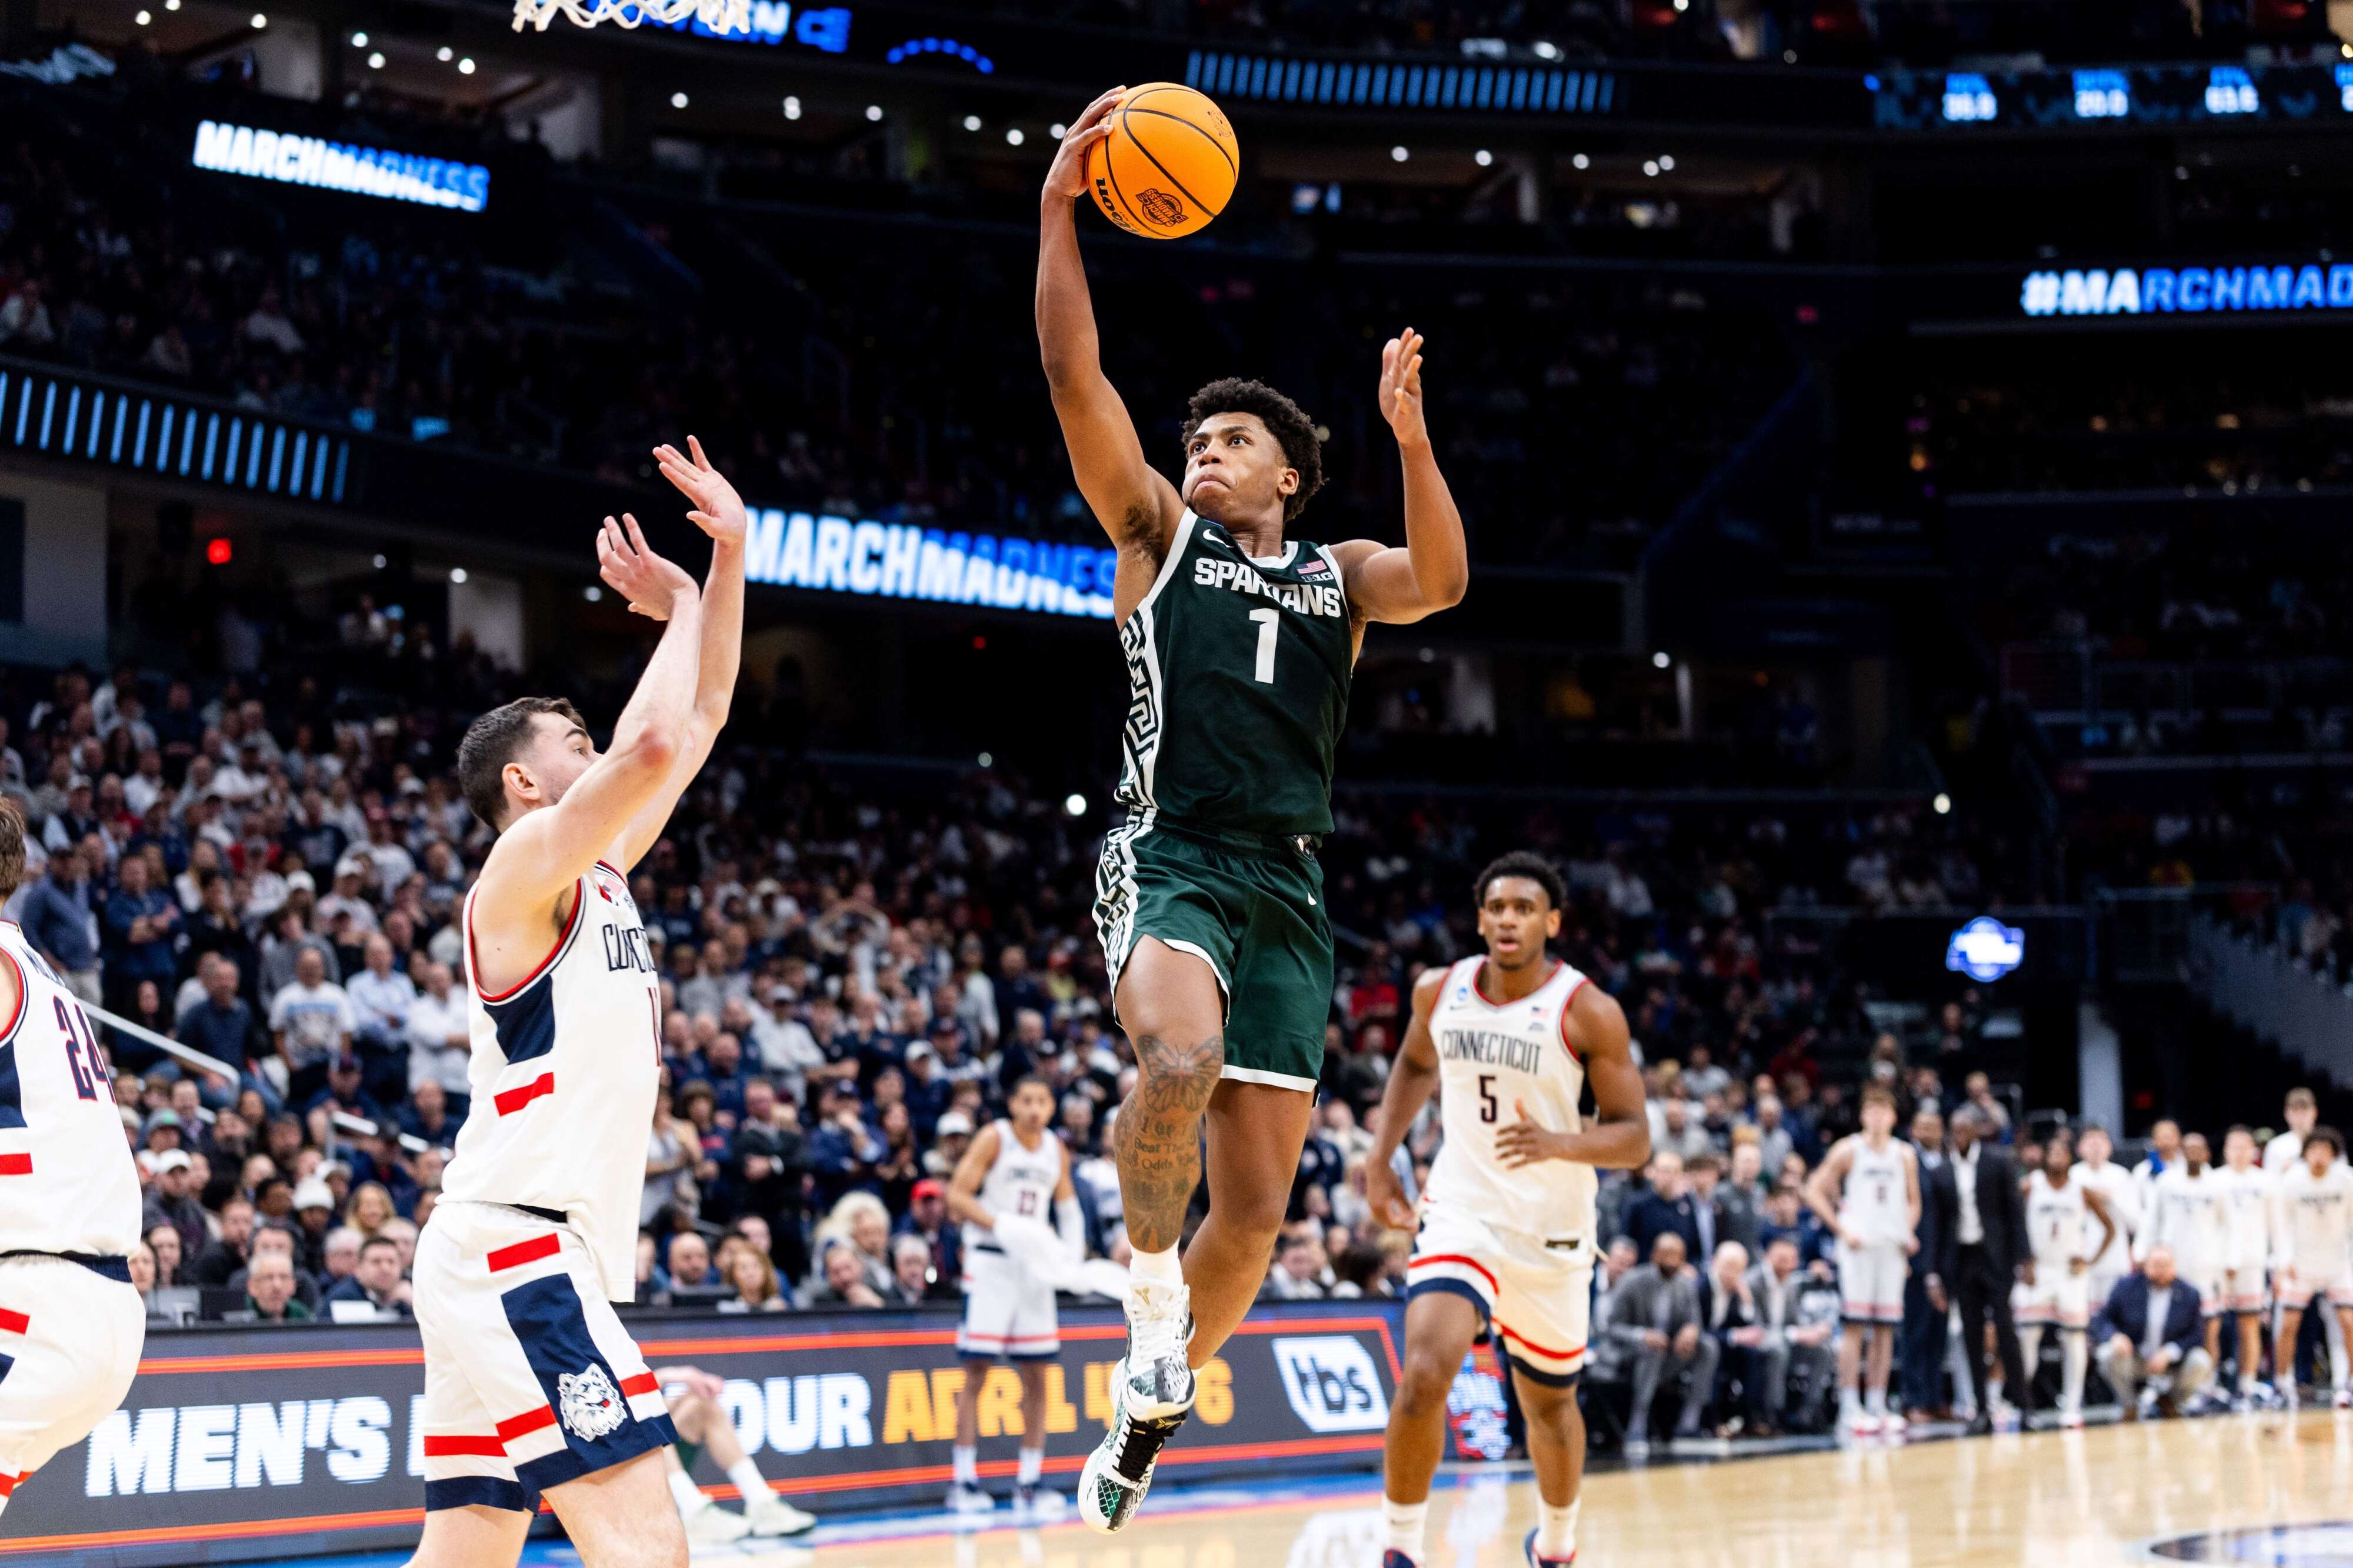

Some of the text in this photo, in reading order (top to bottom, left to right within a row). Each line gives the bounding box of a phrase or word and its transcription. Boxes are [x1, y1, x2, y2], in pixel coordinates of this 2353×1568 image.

[1194, 558, 1341, 618] SPARTANS
[1249, 608, 1279, 684] 1
[53, 995, 118, 1106] 24
[1442, 1028, 1541, 1075] CONNECTICUT
[1479, 1074, 1498, 1123] 5
[1291, 1356, 1372, 1414] tbs
[85, 1396, 391, 1498] MEN'S
[663, 1372, 874, 1456] OUR
[883, 1363, 1078, 1444] APRL
[1194, 1356, 1234, 1426] 6
